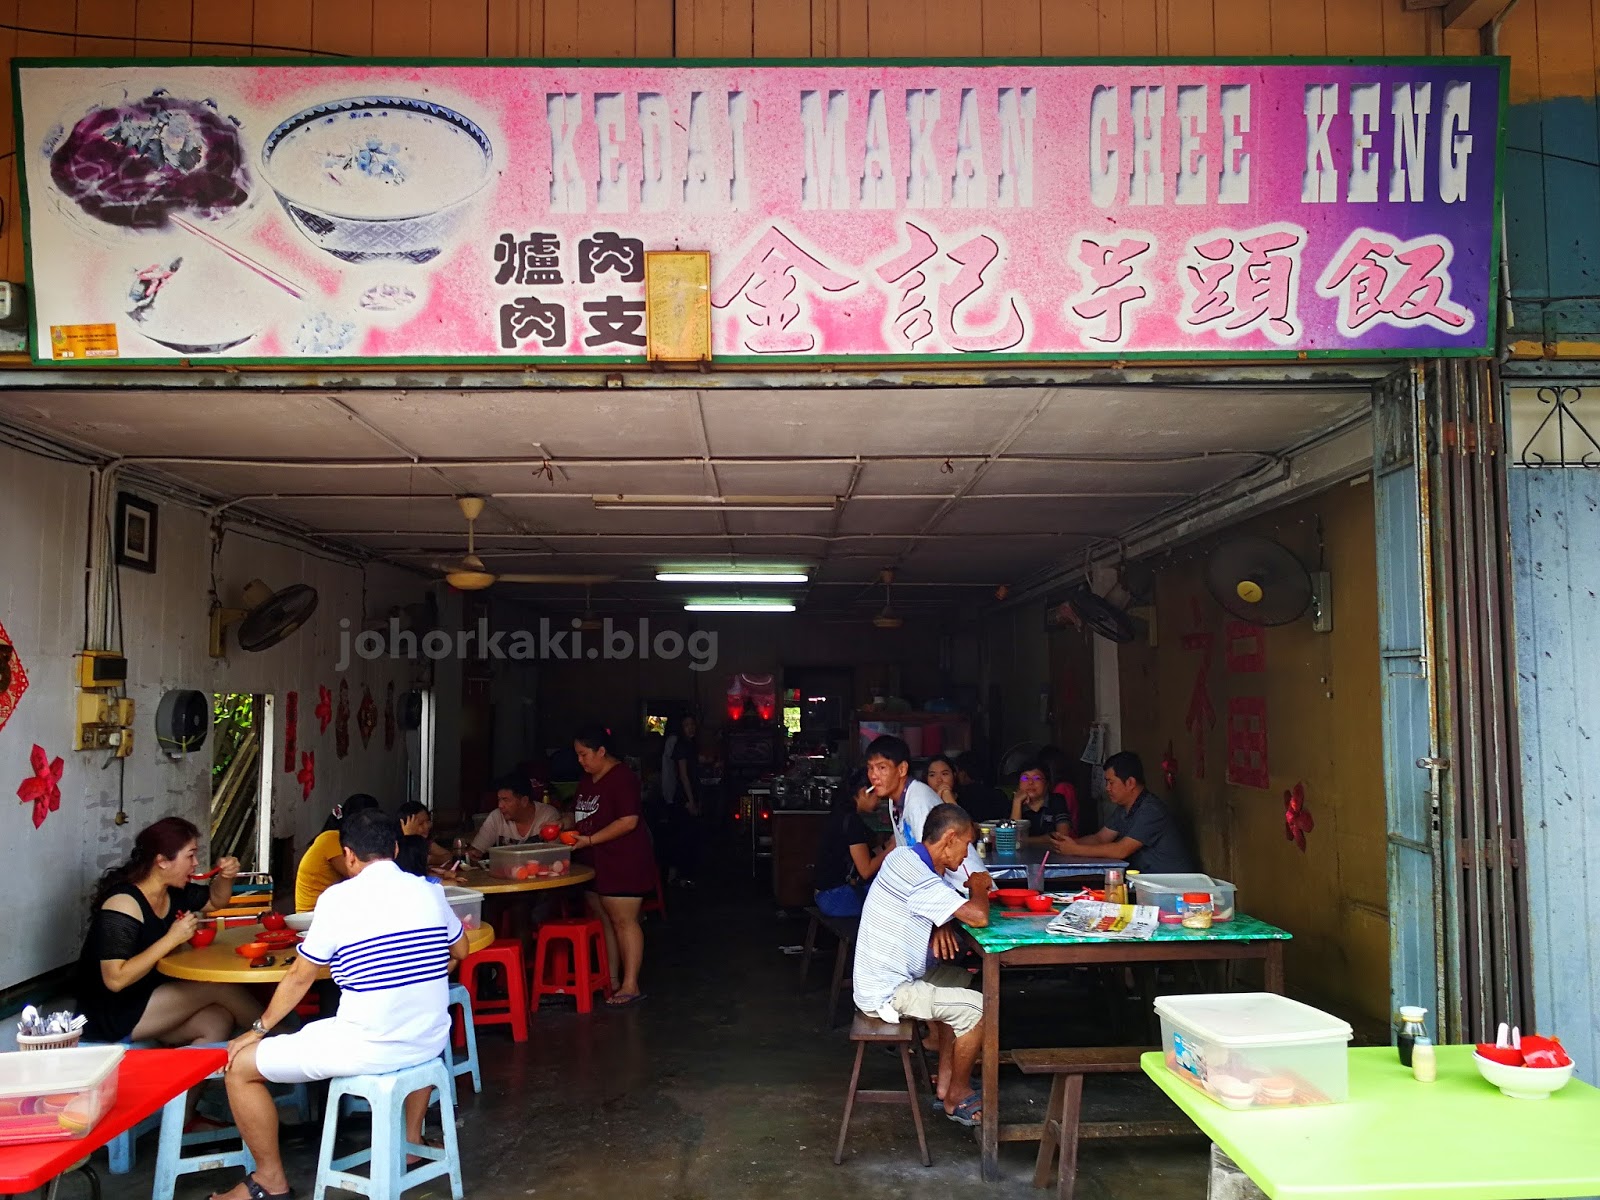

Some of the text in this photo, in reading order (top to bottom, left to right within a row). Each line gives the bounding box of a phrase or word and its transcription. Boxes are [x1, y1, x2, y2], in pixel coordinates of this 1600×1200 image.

[545, 81, 1473, 214] KEDAI MAKAN CHEE KENG
